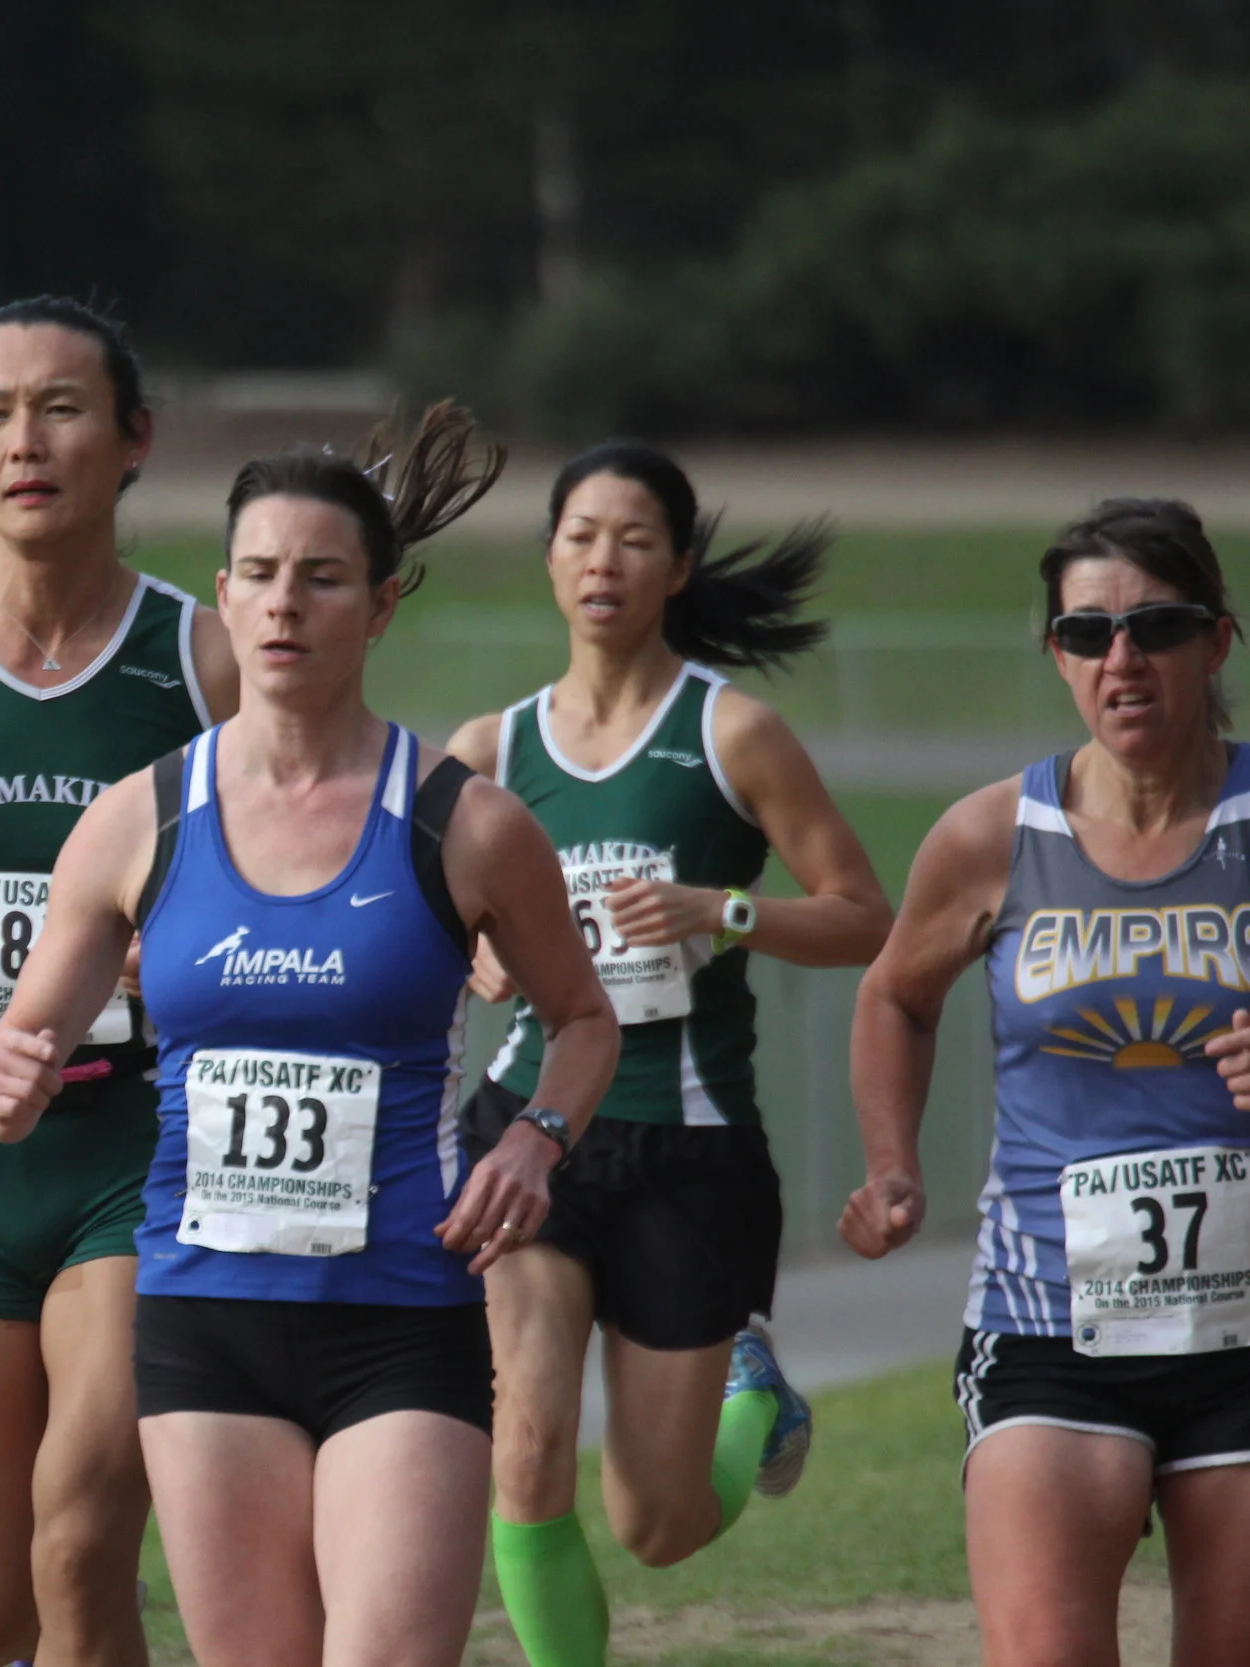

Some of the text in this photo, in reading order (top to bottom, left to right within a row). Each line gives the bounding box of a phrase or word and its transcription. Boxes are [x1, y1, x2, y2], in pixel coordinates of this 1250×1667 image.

[222, 948, 345, 976] IMPALA
[220, 973, 346, 987] RACING TEAM
[197, 1059, 364, 1093] PA/USATF XC
[221, 1093, 328, 1173] 133
[195, 1171, 353, 1199] 2014 CHAMPIONSHIPS
[1072, 1152, 1247, 1198] PA/USATF XC
[214, 1190, 228, 1202] the
[230, 1191, 255, 1204] 2015
[257, 1193, 301, 1208] National
[304, 1198, 341, 1211] Course
[1130, 1192, 1207, 1275] 37
[1084, 1280, 1124, 1296] 2014
[1095, 1289, 1245, 1309] On the 2015 National Course
